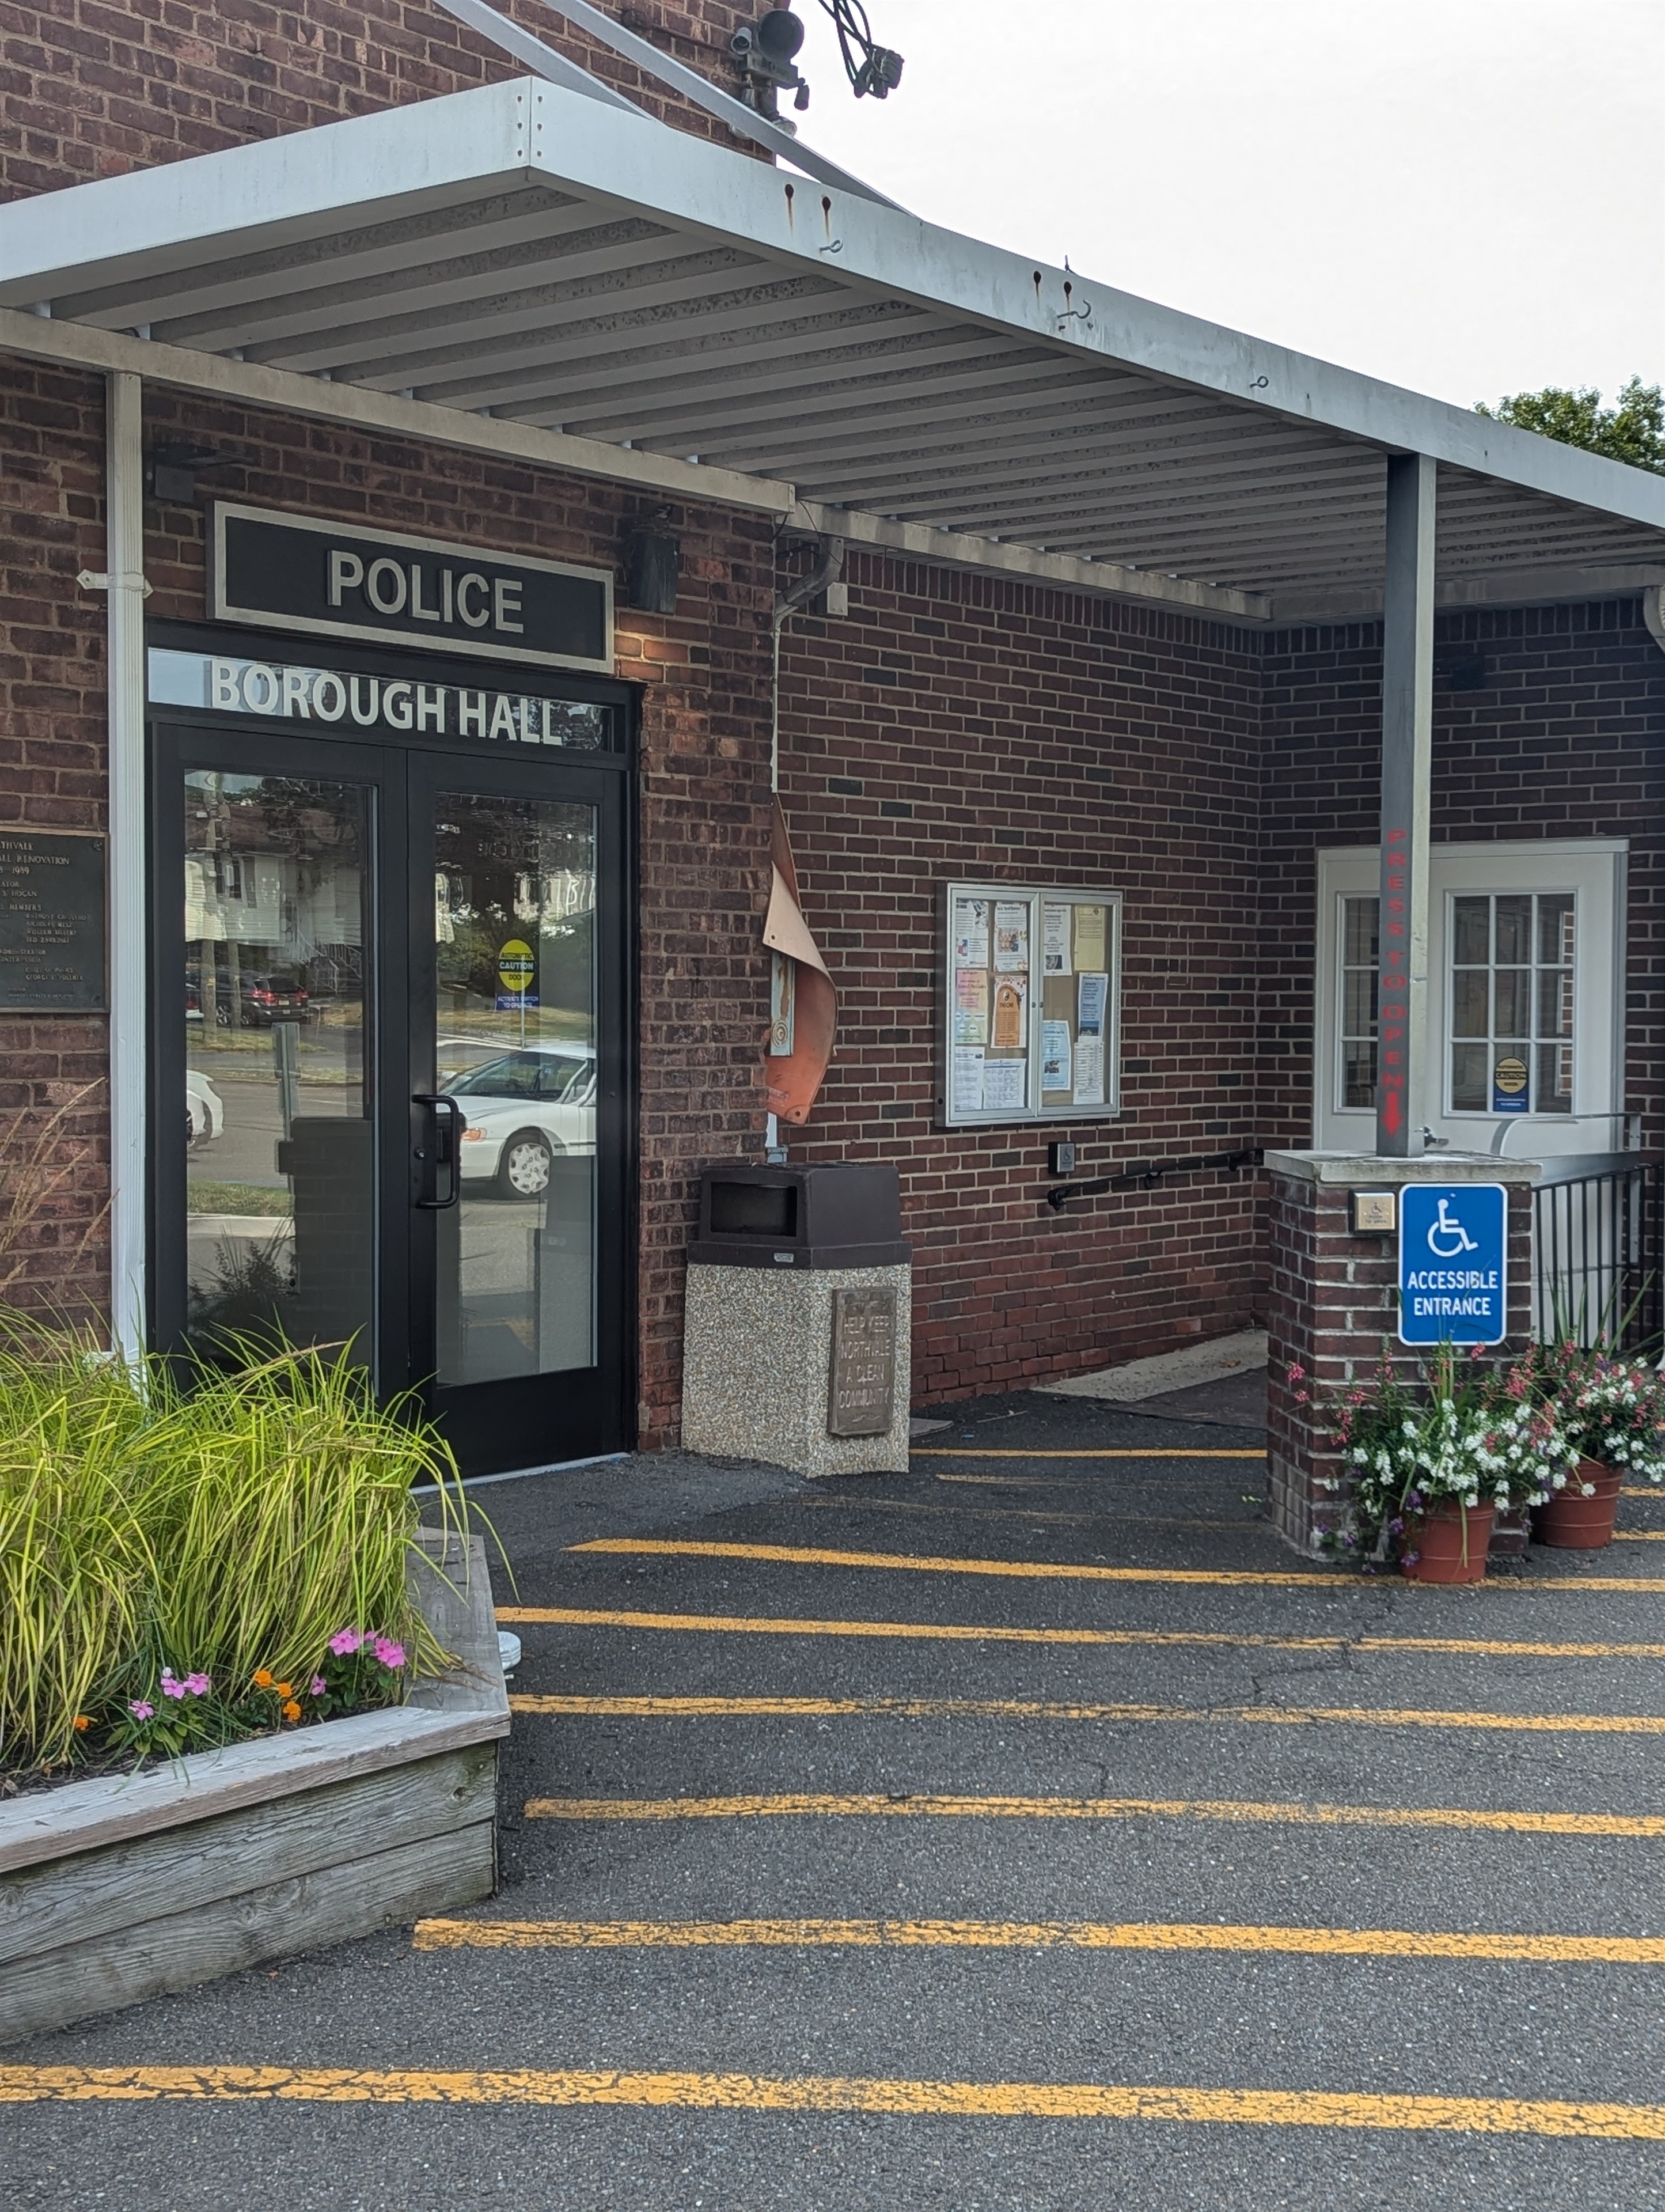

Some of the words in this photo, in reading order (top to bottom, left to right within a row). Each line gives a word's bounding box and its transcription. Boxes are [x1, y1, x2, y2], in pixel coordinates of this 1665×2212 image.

[329, 550, 524, 634] POLICE
[209, 658, 446, 735] BOROUGH
[459, 689, 563, 747] HALL
[1387, 828, 1407, 937] PRESS
[499, 961, 533, 969] CAUTION
[1383, 952, 1407, 990] TO
[1382, 1005, 1407, 1088] OPEN
[1408, 1271, 1499, 1290] ACCESSIBLE
[1413, 1297, 1492, 1316] ENTRANCE
[843, 1315, 866, 1335] HELP
[867, 1315, 890, 1334] KEEP
[840, 1339, 891, 1359] NORTHVALE
[856, 1363, 885, 1383] CLEAN
[839, 1387, 890, 1409] COMMUNITY
